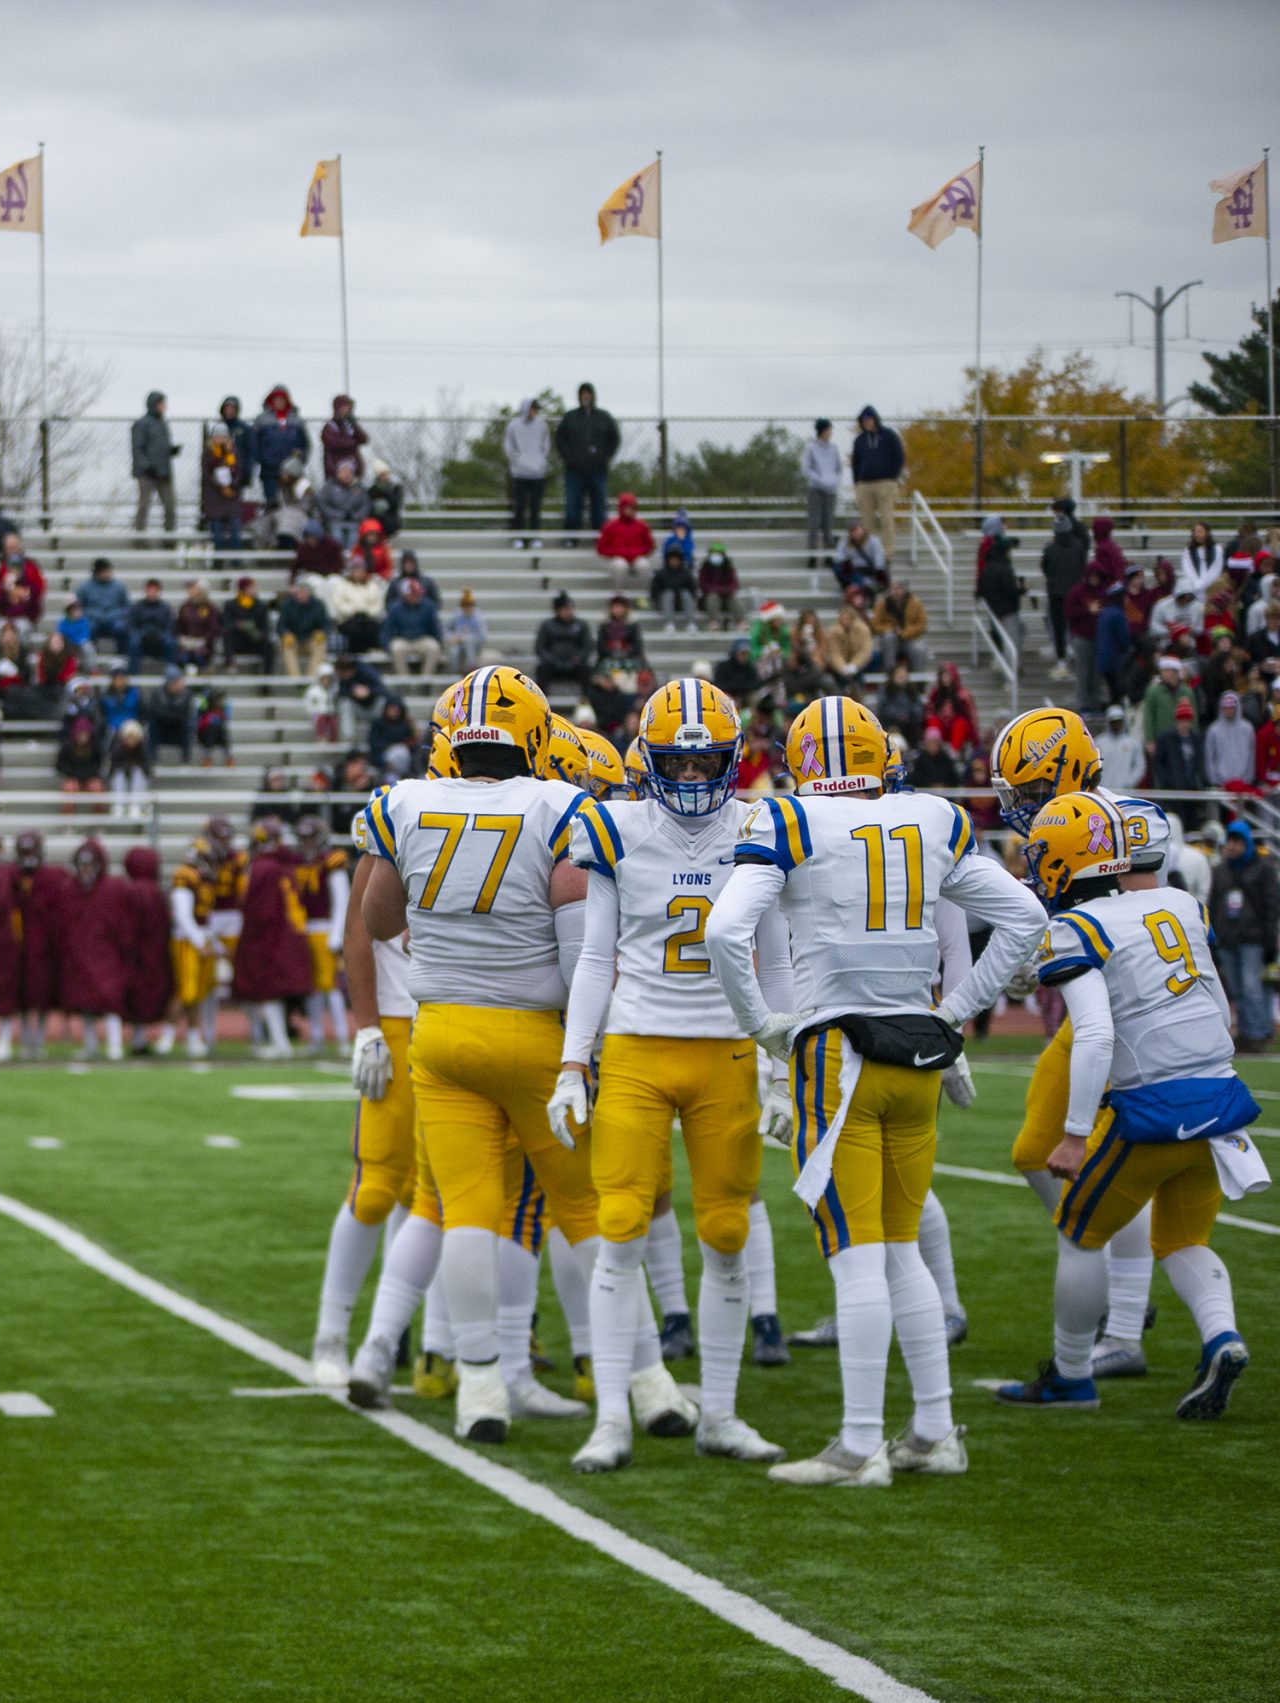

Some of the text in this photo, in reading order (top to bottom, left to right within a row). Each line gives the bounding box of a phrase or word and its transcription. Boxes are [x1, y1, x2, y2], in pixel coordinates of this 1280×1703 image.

[456, 729, 500, 742] Riddell
[1025, 727, 1067, 769] Lions
[812, 777, 866, 792] Riddell
[418, 811, 525, 914] 77
[672, 873, 712, 886] LYONS
[849, 824, 925, 932] 11
[662, 895, 714, 974] 2
[1142, 909, 1203, 997] 9
